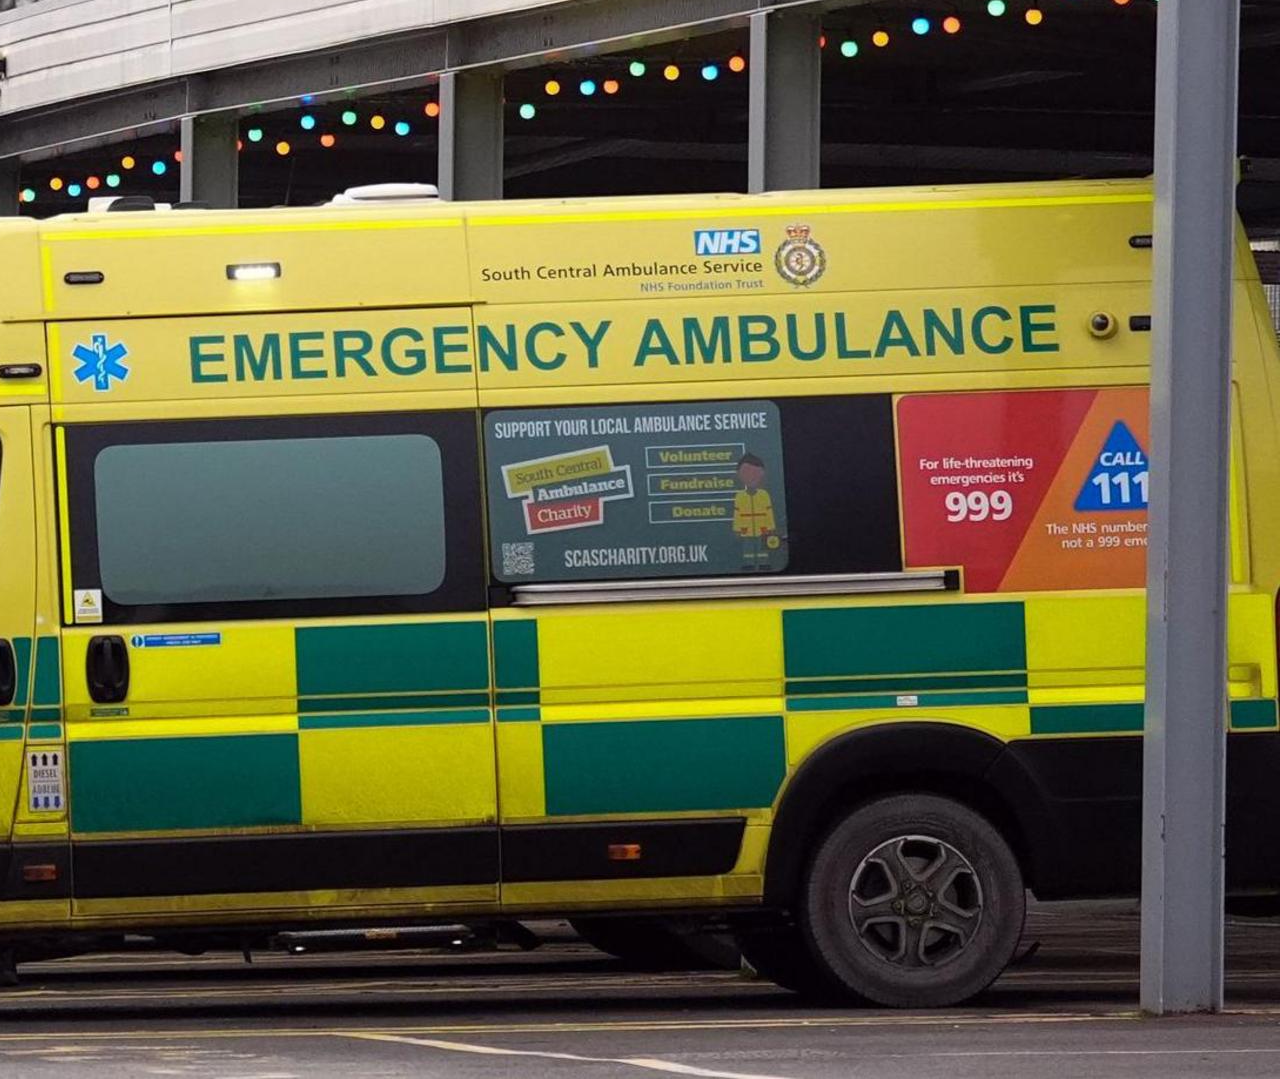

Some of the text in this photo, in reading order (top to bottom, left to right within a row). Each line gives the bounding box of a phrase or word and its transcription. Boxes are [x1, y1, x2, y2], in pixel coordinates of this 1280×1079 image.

[697, 230, 759, 255] NHS
[482, 259, 763, 282] South Central Ambulance Service
[640, 279, 764, 293] NHS Foundation Trust
[189, 305, 1060, 384] EMERGENCY AMBULANCE
[495, 412, 768, 439] SUPPORT YOUR LOCAL AMBULANCE SERVICE
[659, 450, 733, 464] Volunteer
[920, 456, 1033, 470] For life-threatening
[1100, 451, 1144, 466] CALL
[515, 457, 602, 485] South Central
[931, 473, 1006, 487] emergencies
[537, 477, 625, 502] Ambulance
[660, 477, 734, 491] Fundraise
[1092, 472, 1149, 504] 111
[537, 505, 592, 524] Charity
[672, 505, 726, 518] Donate
[945, 490, 1013, 522] 999
[1046, 521, 1148, 535] The NHS number
[1062, 538, 1083, 549] not
[1086, 539, 1094, 547] a
[1098, 537, 1120, 548] 999
[565, 545, 708, 568] SCASCHARITY.ORG.UK
